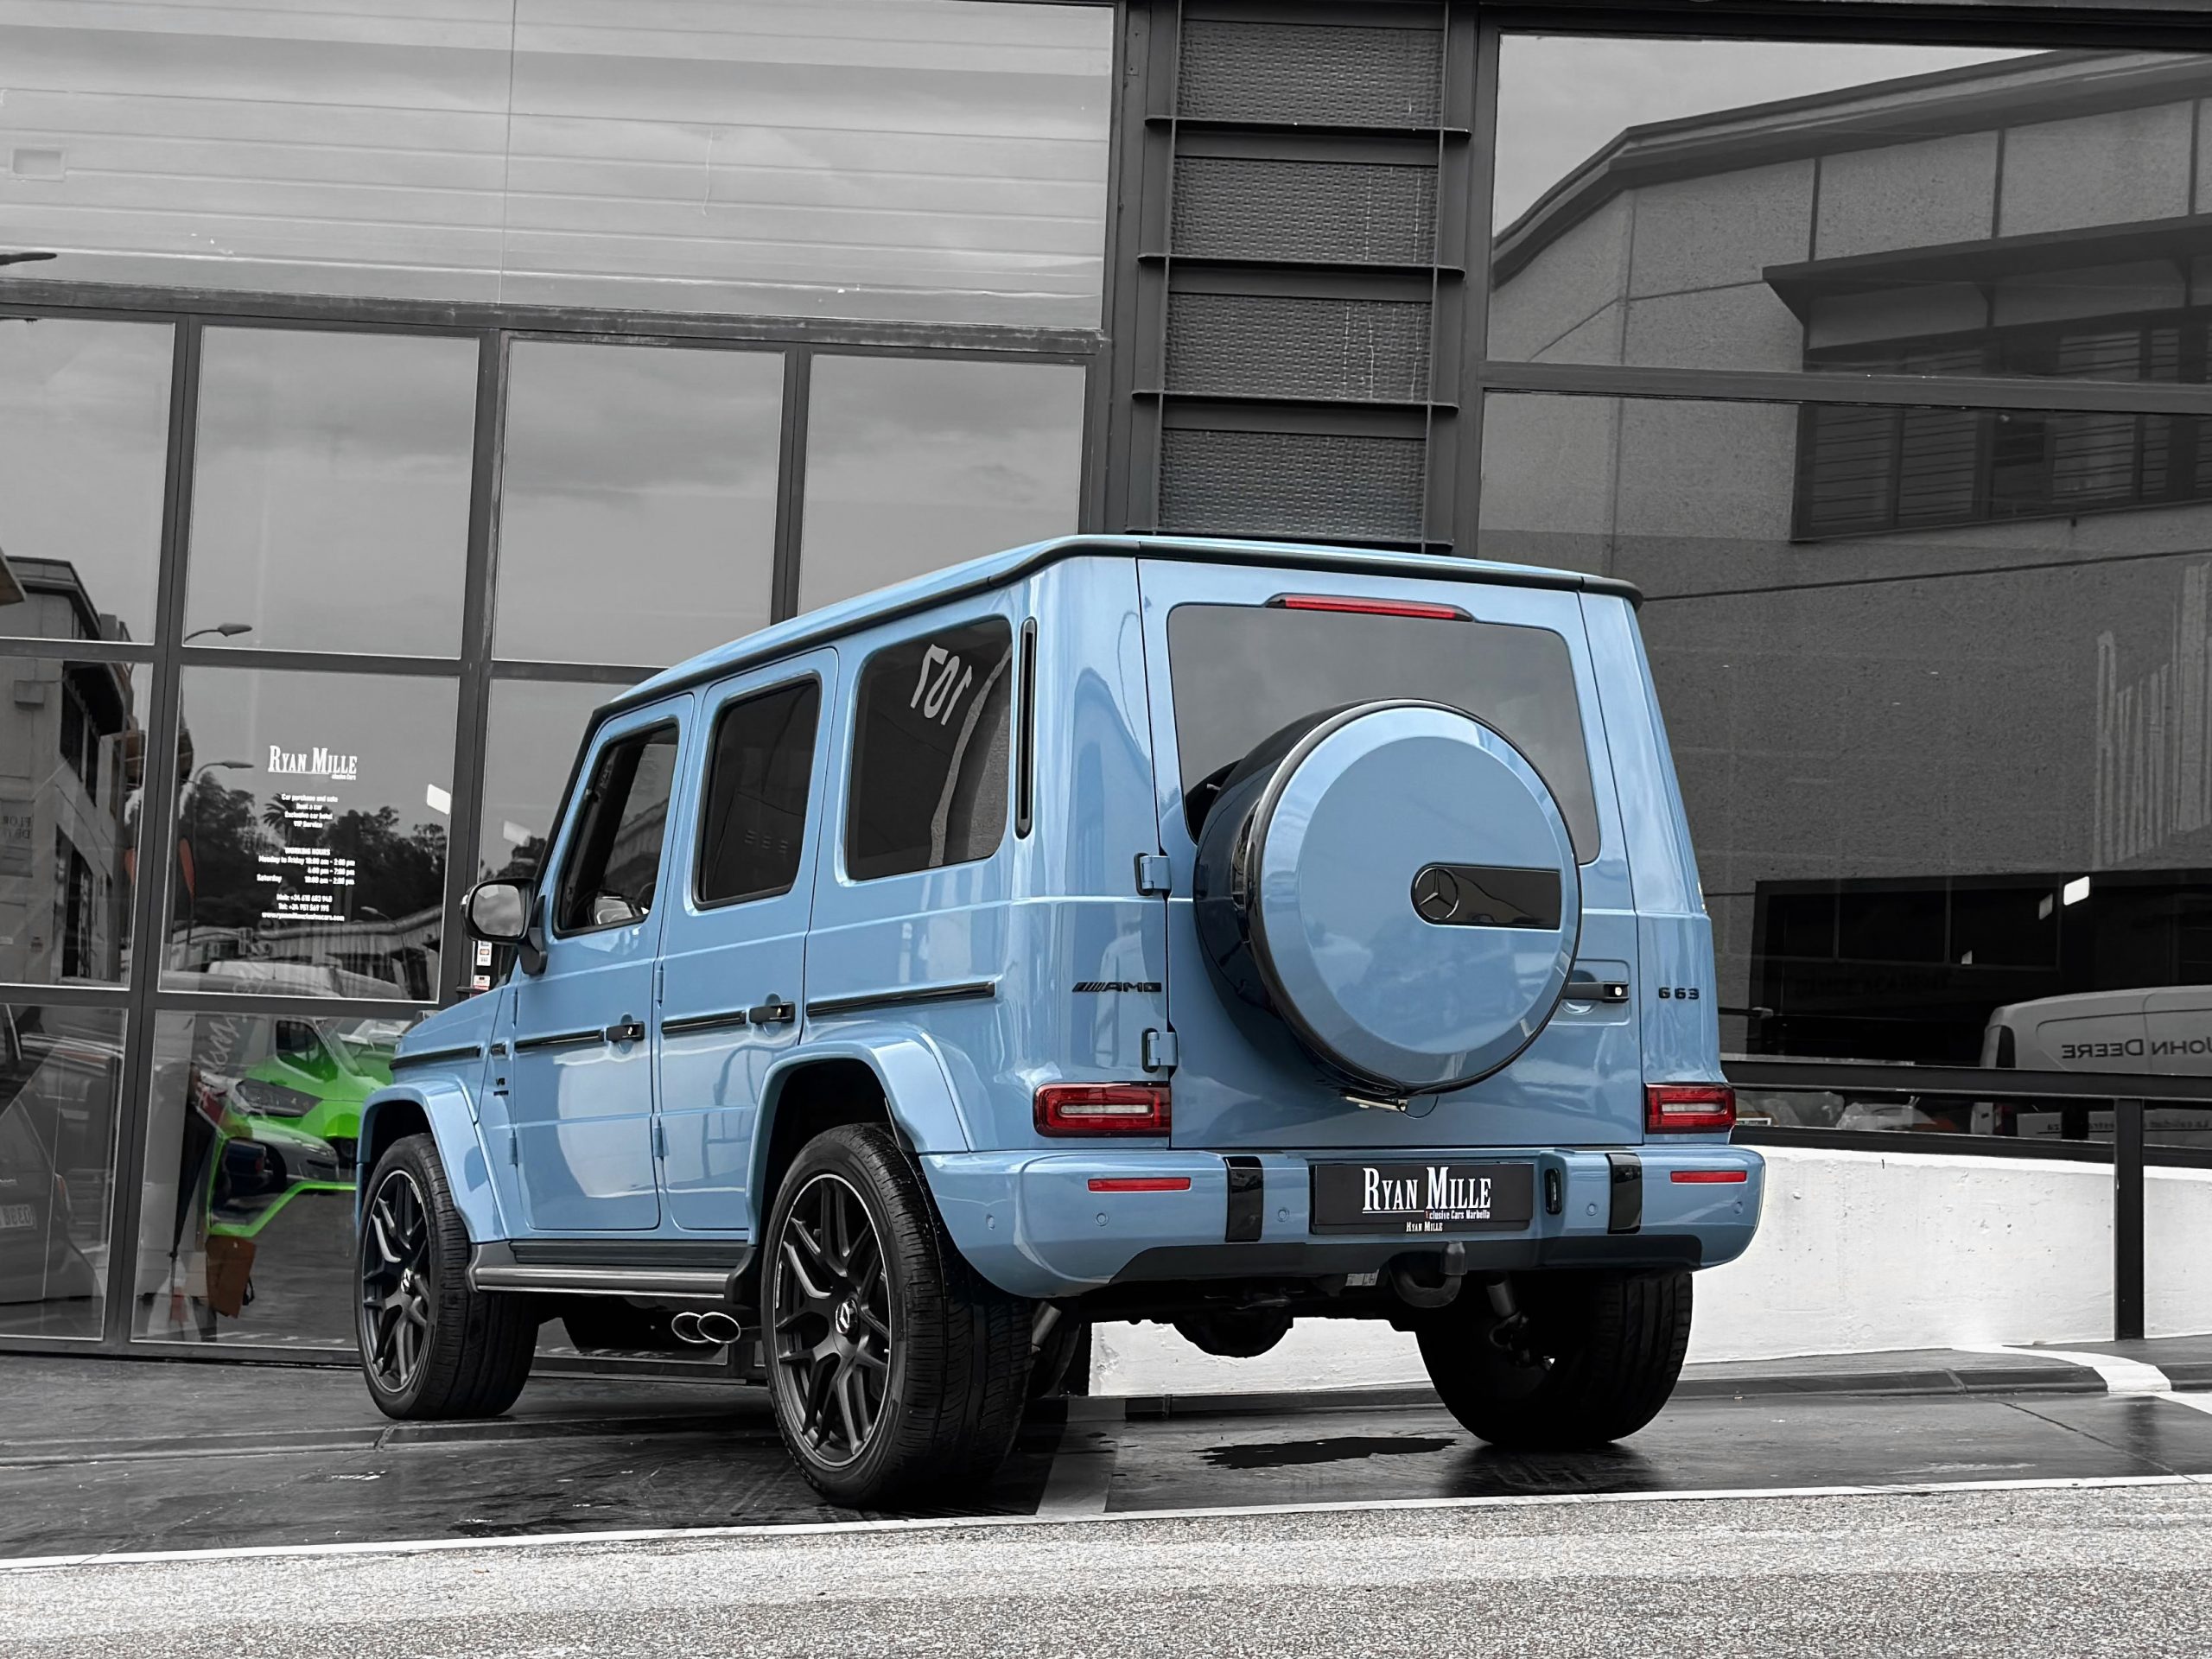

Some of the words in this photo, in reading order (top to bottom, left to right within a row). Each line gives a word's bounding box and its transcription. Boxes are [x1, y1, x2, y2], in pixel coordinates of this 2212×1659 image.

[268, 746, 307, 772] RYAN
[311, 747, 357, 774] MILLE
[1098, 982, 1161, 992] AMG
[1362, 1167, 1419, 1211] RYAN
[1426, 1166, 1491, 1209] MILLE
[1451, 1210, 1464, 1219] Cars
[1466, 1210, 1491, 1219] Marbella
[1406, 1222, 1422, 1232] RYAN
[1424, 1221, 1443, 1231] MILLE
